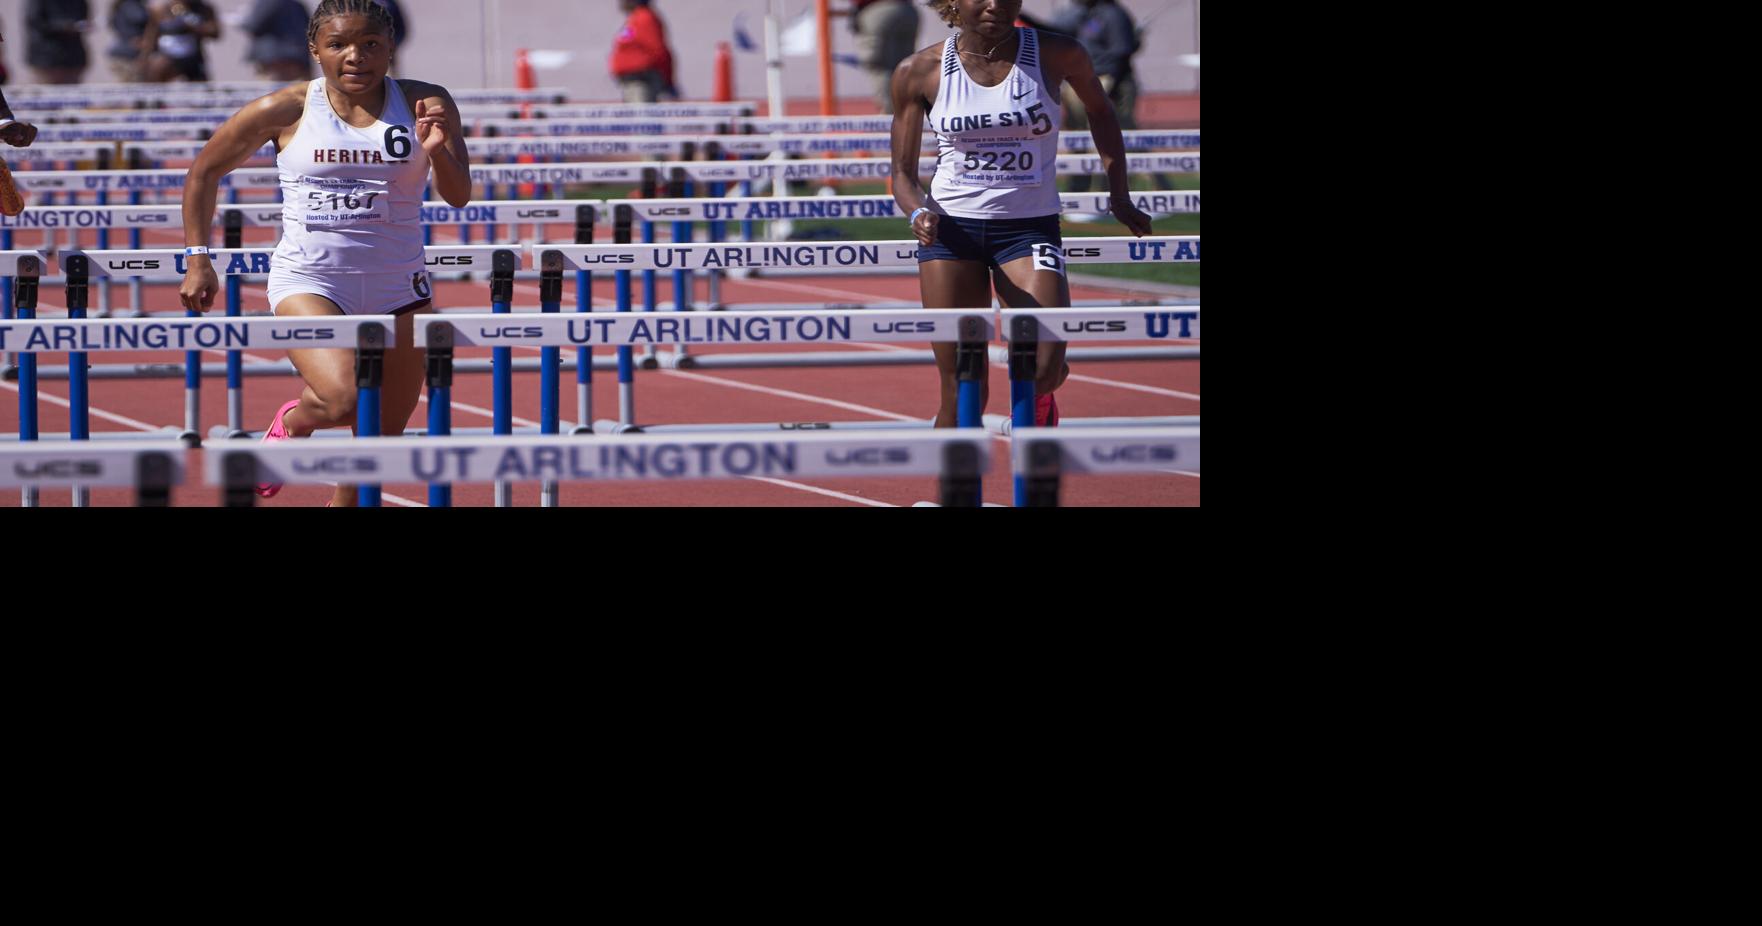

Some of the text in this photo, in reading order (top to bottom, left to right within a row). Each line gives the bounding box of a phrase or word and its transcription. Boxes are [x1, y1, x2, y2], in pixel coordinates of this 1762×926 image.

[941, 111, 1028, 132] LONE ST
[1025, 102, 1053, 136] 5
[384, 125, 412, 159] 6
[314, 149, 409, 163] HERITA
[963, 150, 1034, 171] 5220
[470, 168, 583, 183] RLINGTON
[748, 165, 775, 178] UT
[783, 162, 892, 177] ARLINGTO
[84, 175, 111, 189] UT
[307, 191, 379, 211] 5167
[648, 200, 895, 219] UCS UT ARLINGTON
[126, 213, 168, 222] UCS
[517, 208, 560, 218] UCS
[585, 253, 635, 264] UCS
[653, 248, 693, 268] UT
[702, 245, 879, 267] ARLINGTON
[1039, 245, 1061, 270] 5
[1128, 241, 1166, 260] UT
[109, 259, 160, 270] UCS
[481, 316, 936, 343] UCS UT ARLINGTON UCS
[1063, 312, 1197, 338] UCS UT
[26, 323, 249, 350] ARLINGTON
[271, 328, 335, 340] UCS
[291, 442, 912, 481] UCS UT ARLINGTON UCS
[1091, 444, 1178, 464] UCS
[13, 458, 105, 478] UCS
